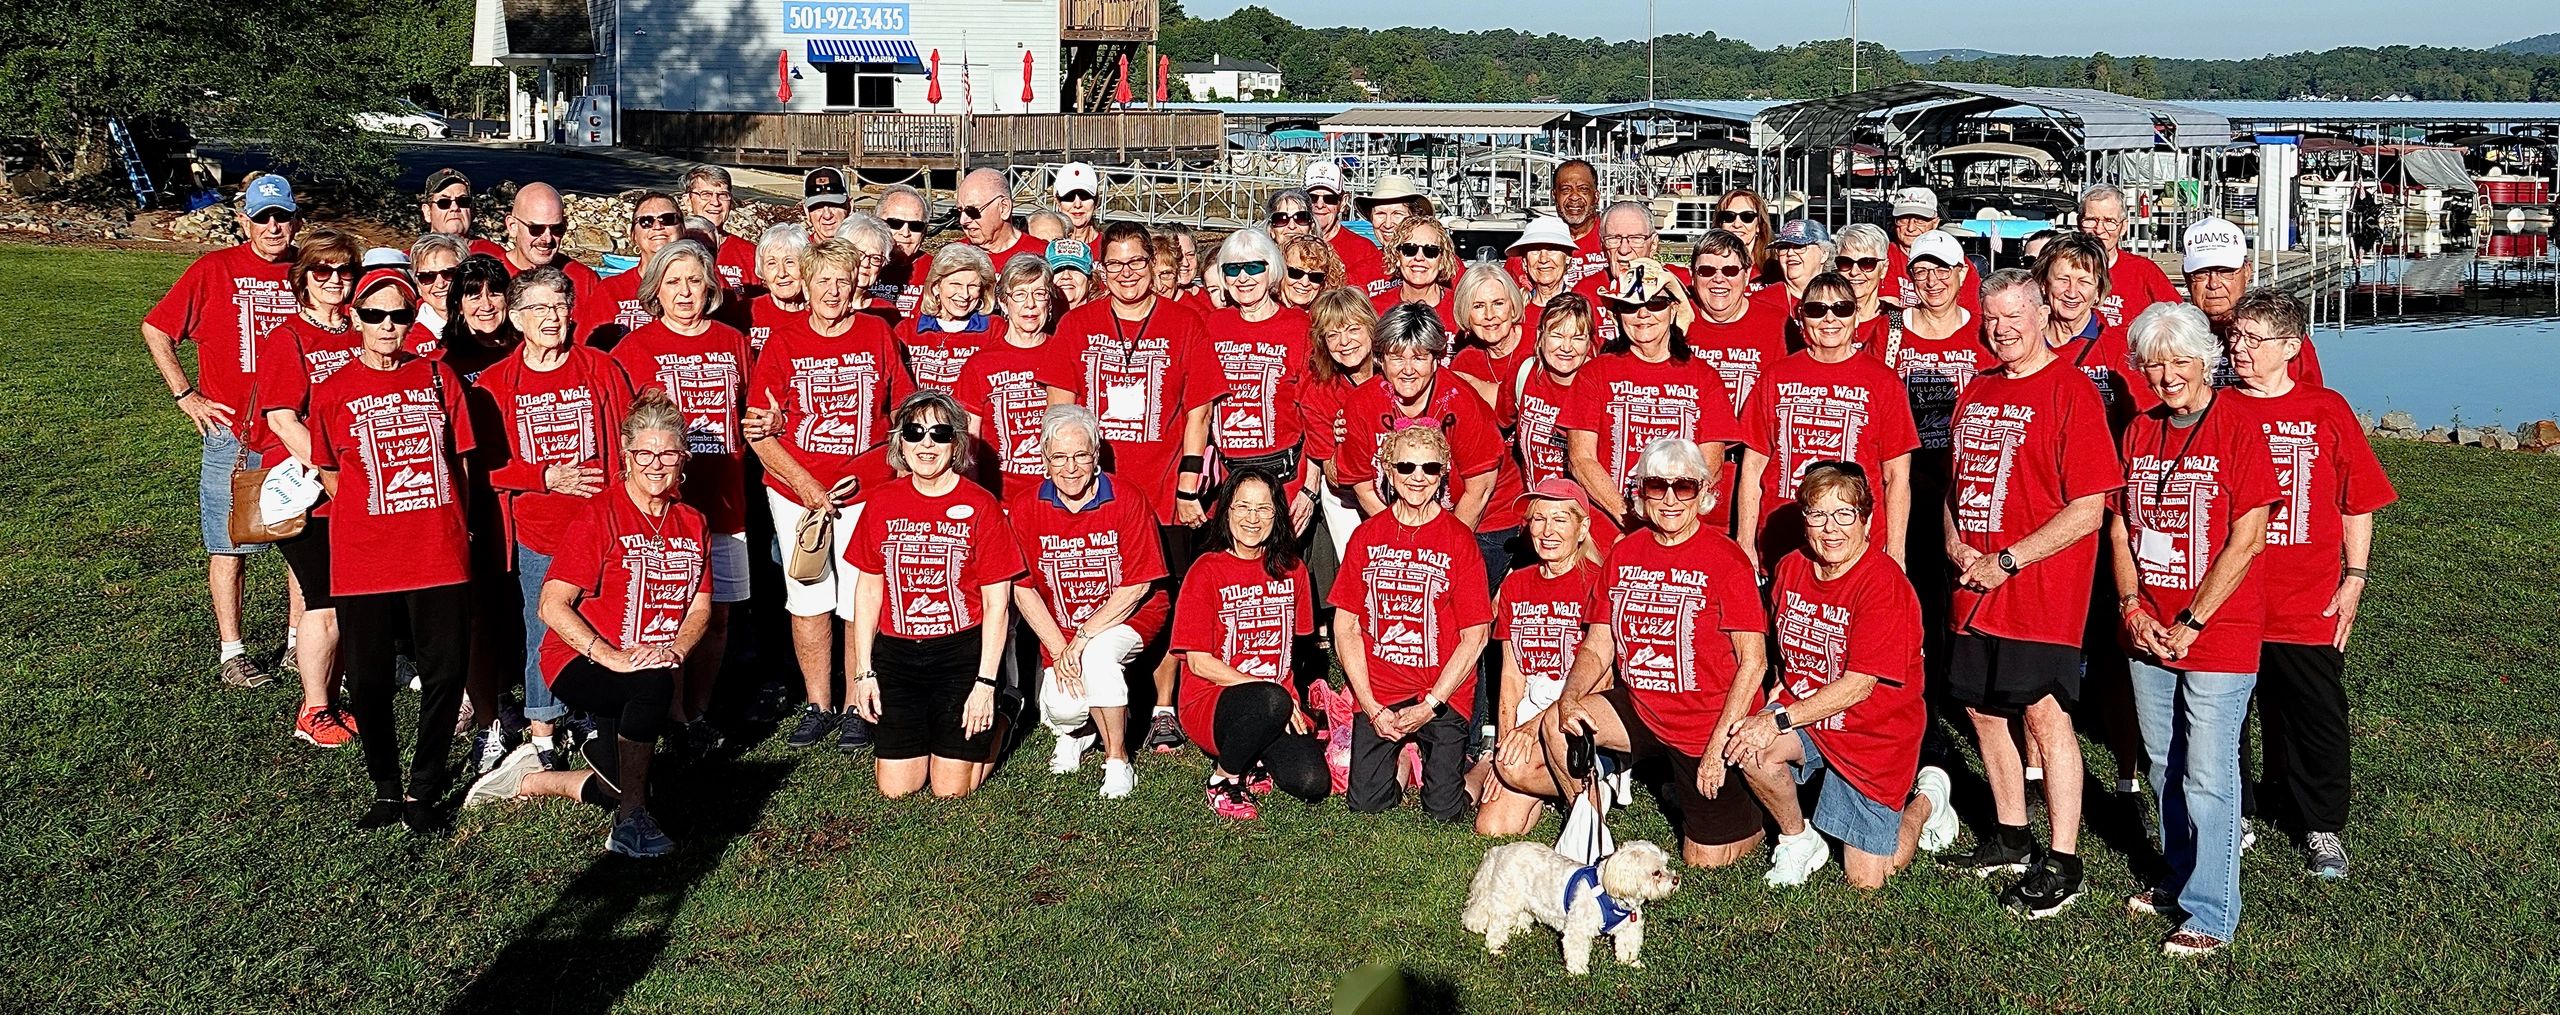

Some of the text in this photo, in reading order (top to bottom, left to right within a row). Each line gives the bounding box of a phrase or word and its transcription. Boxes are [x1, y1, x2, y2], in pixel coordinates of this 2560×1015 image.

[789, 5, 904, 31] 501-922-3435
[834, 55, 898, 64] BALBOA MARINA
[589, 99, 602, 143] ICE
[2195, 232, 2230, 244] UAMS
[718, 265, 743, 278] Walk
[233, 277, 280, 290] Village
[1137, 337, 1170, 350] Walk
[1214, 340, 1288, 357] Village Walk
[306, 349, 349, 366] Village
[907, 344, 949, 360] Village
[1727, 347, 1762, 362] Walk
[1943, 349, 1978, 364] Walk
[654, 351, 737, 369] Village Walk
[791, 351, 876, 375] Village Walk
[987, 370, 1034, 387] Village
[1100, 373, 1137, 383] VILLAGE
[1911, 376, 1929, 384] 22nd
[559, 386, 591, 401] Walk
[681, 389, 715, 398] VILLAGE
[919, 382, 952, 391] VILLAGE
[1610, 380, 1700, 400] Village Walk
[1777, 383, 1870, 403] Village Walk
[1910, 385, 1948, 394] VILLAGE
[346, 387, 440, 415] Village Walk
[696, 390, 726, 406] walk
[813, 393, 849, 403] VILLAGE
[830, 394, 858, 409] walk
[1008, 410, 1044, 419] VILLAGE
[2002, 404, 2036, 423] Walk
[1104, 429, 1137, 440] 2023
[1630, 425, 1667, 436] VILLAGE
[1793, 427, 1831, 438] VILLAGE
[2276, 421, 2318, 436] Walk
[377, 437, 419, 450] VILLAGE
[535, 434, 570, 444] VILLAGE
[551, 433, 580, 451] walk
[1228, 437, 1258, 448] 2023
[1808, 432, 1842, 448] walk
[397, 437, 432, 457] walk
[690, 443, 720, 453] 2023
[816, 443, 849, 454] 2023
[2183, 455, 2220, 473] Walk
[394, 497, 429, 514] 2023
[886, 518, 971, 537] Village Walk
[2160, 512, 2188, 529] walk
[667, 536, 701, 552] Walk
[1039, 535, 1085, 553] Village
[1367, 544, 1452, 569] Village Walk
[900, 566, 935, 576] VILLAGE
[915, 570, 946, 586] walk
[1618, 565, 1709, 587] Village Walk
[1062, 580, 1097, 589] VILLAGE
[2144, 571, 2180, 588] 2023
[1078, 581, 1109, 597] walk
[1219, 583, 1263, 604] Village
[1377, 592, 1412, 603] VILLAGE
[1392, 597, 1423, 615] walk
[1511, 601, 1582, 619] Village Walk
[1624, 614, 1664, 626] VILLAGE
[1822, 603, 1851, 626] Walk
[913, 623, 946, 635] 2023
[1237, 630, 1271, 640] VILLAGE
[1640, 620, 1675, 637] walk
[1799, 659, 1828, 674] walk
[1636, 677, 1670, 691] 2023
